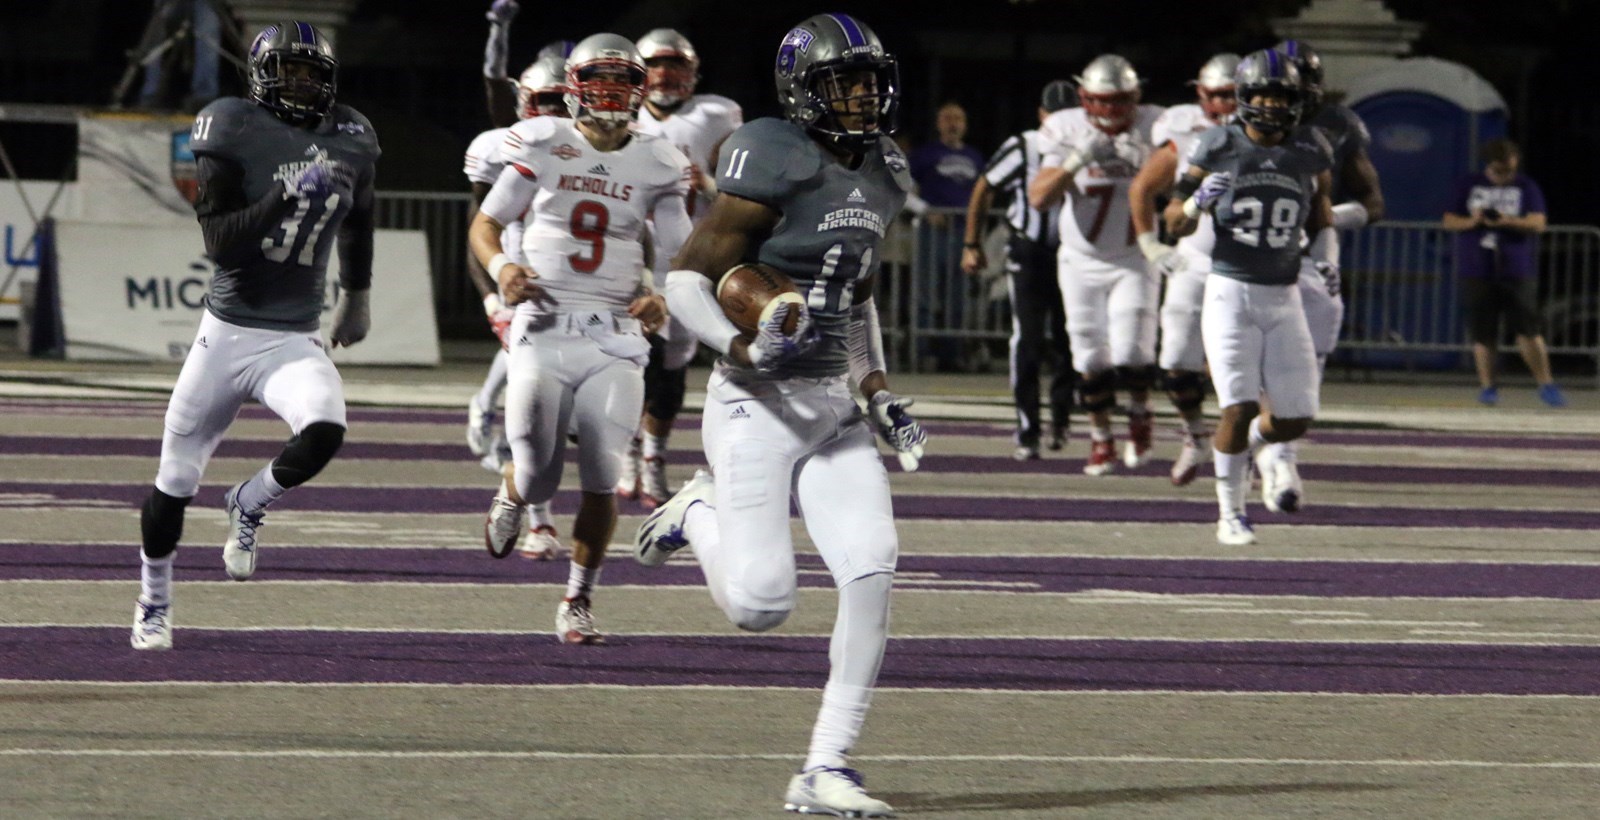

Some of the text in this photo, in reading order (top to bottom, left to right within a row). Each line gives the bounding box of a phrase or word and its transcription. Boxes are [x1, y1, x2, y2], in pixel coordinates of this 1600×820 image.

[193, 116, 213, 140] 31
[725, 148, 749, 179] 11
[557, 174, 634, 202] NICHOLLS
[261, 193, 339, 266] 31
[825, 208, 886, 230] CENTRAL
[568, 200, 609, 274] 9
[808, 244, 873, 312] 11
